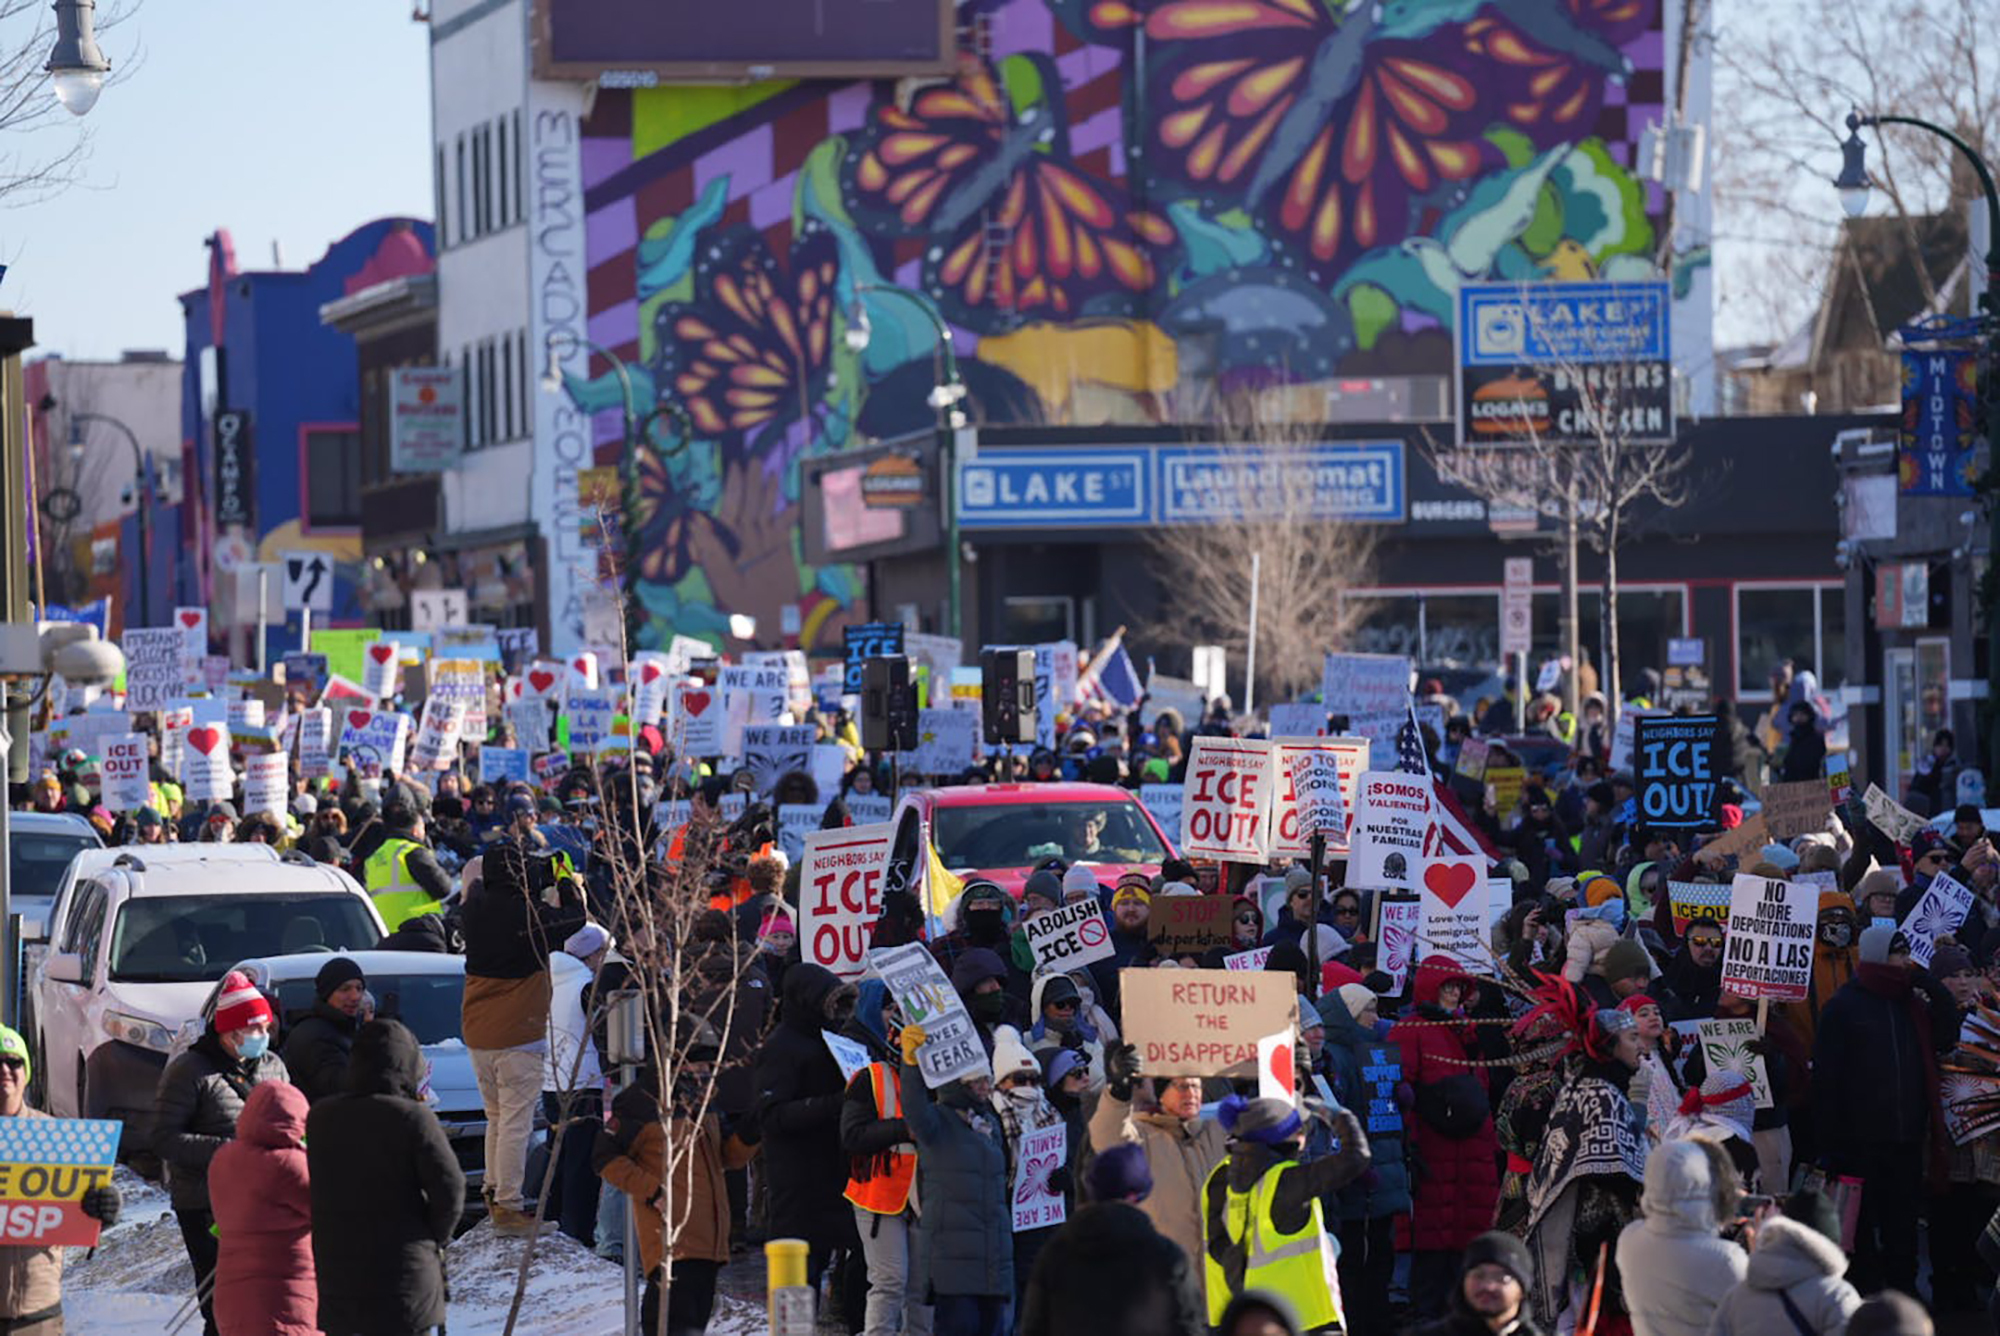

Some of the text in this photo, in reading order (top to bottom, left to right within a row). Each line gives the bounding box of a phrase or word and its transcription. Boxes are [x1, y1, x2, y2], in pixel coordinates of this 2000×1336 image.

[1928, 357, 1946, 490] MIDTOWN
[1174, 460, 1382, 490] Laundromat
[1001, 472, 1106, 503] LAKE
[724, 671, 788, 688] WE ARE
[745, 730, 810, 746] WE ARE
[108, 743, 139, 758] ICE
[1642, 741, 1712, 779] ICE
[104, 758, 143, 773] OUT
[1192, 769, 1258, 809] ICE
[1367, 782, 1425, 800] ¡SOMOS
[1642, 781, 1717, 818] OUT!
[1189, 808, 1260, 847] OUT!
[1366, 824, 1423, 839] NUESTRAS
[1391, 816, 1409, 826] POR
[1372, 835, 1421, 849] FAMILIAS
[813, 851, 887, 871] NEIGHBORS SAY
[812, 868, 881, 917] ICE
[1764, 880, 1786, 903] NO
[1934, 873, 1973, 910] WE ARE
[1027, 900, 1099, 943] ABOLISH
[1171, 900, 1222, 924] STOP
[1384, 905, 1404, 921] WE
[1428, 914, 1480, 924] Love Your
[1676, 904, 1730, 921] ICE OU
[1756, 901, 1793, 922] MORE
[1153, 925, 1232, 951] deportation
[1427, 927, 1480, 938] Immigrant
[1731, 915, 1814, 940] DEPORTATIONS
[1038, 930, 1083, 965] ICE
[1727, 936, 1811, 969] NO A LAS
[1227, 956, 1249, 971] WE
[1724, 961, 1808, 985] DEPORTACIONES
[1172, 982, 1256, 1006] RETURN
[1194, 1013, 1229, 1030] THE
[1700, 1020, 1755, 1037] WE ARE
[924, 1022, 961, 1046] OVER
[931, 1040, 975, 1072] FEAR
[1023, 1132, 1064, 1158] FAMILY
[19, 1166, 108, 1197] OUT
[1015, 1203, 1064, 1228] WE ARE
